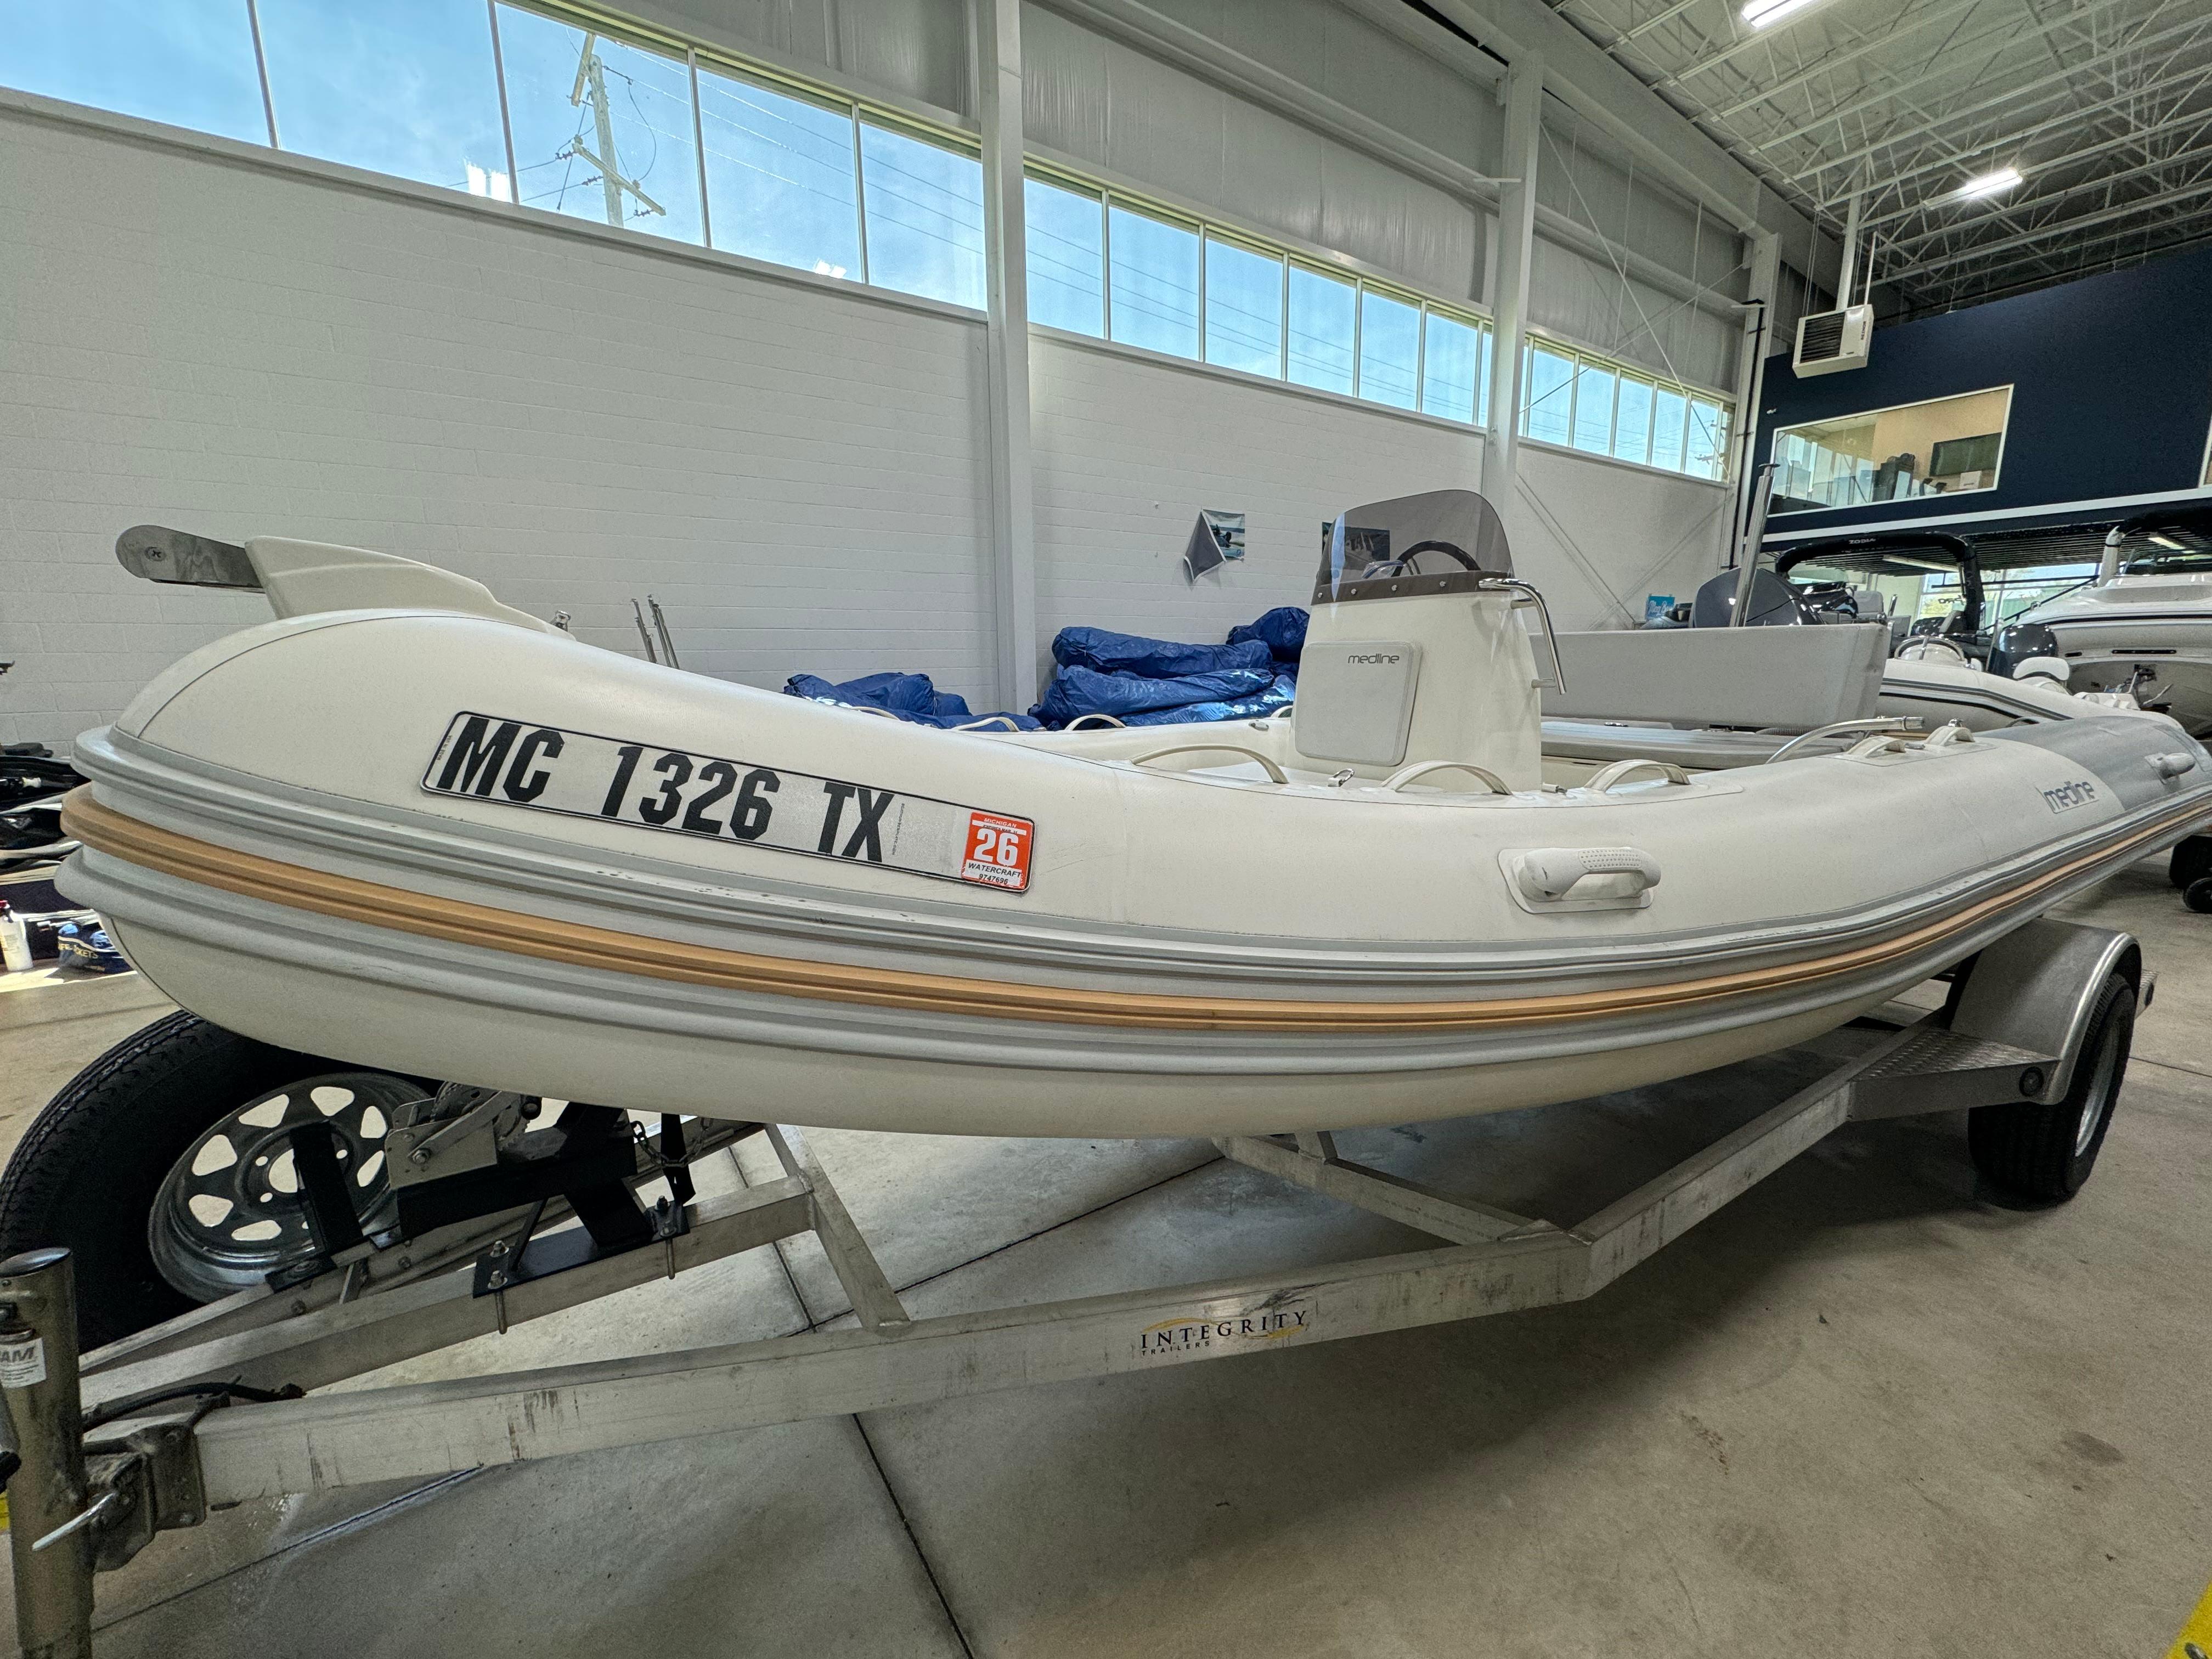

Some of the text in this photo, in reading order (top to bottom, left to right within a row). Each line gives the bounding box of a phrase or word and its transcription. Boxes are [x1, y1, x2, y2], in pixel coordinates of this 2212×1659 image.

[1347, 653, 1400, 664] medline
[436, 716, 895, 862] MC 1326 TX
[2044, 781, 2095, 810] medline
[984, 817, 1017, 828] MICHIGAN
[974, 828, 1019, 866] 26
[968, 862, 1022, 878] WATERCRAFT
[979, 873, 1008, 885] 9747696
[1141, 1311, 1306, 1349] INTEGRITY
[0, 1346, 36, 1363] AM
[1142, 1341, 1210, 1356] TRAILERS
